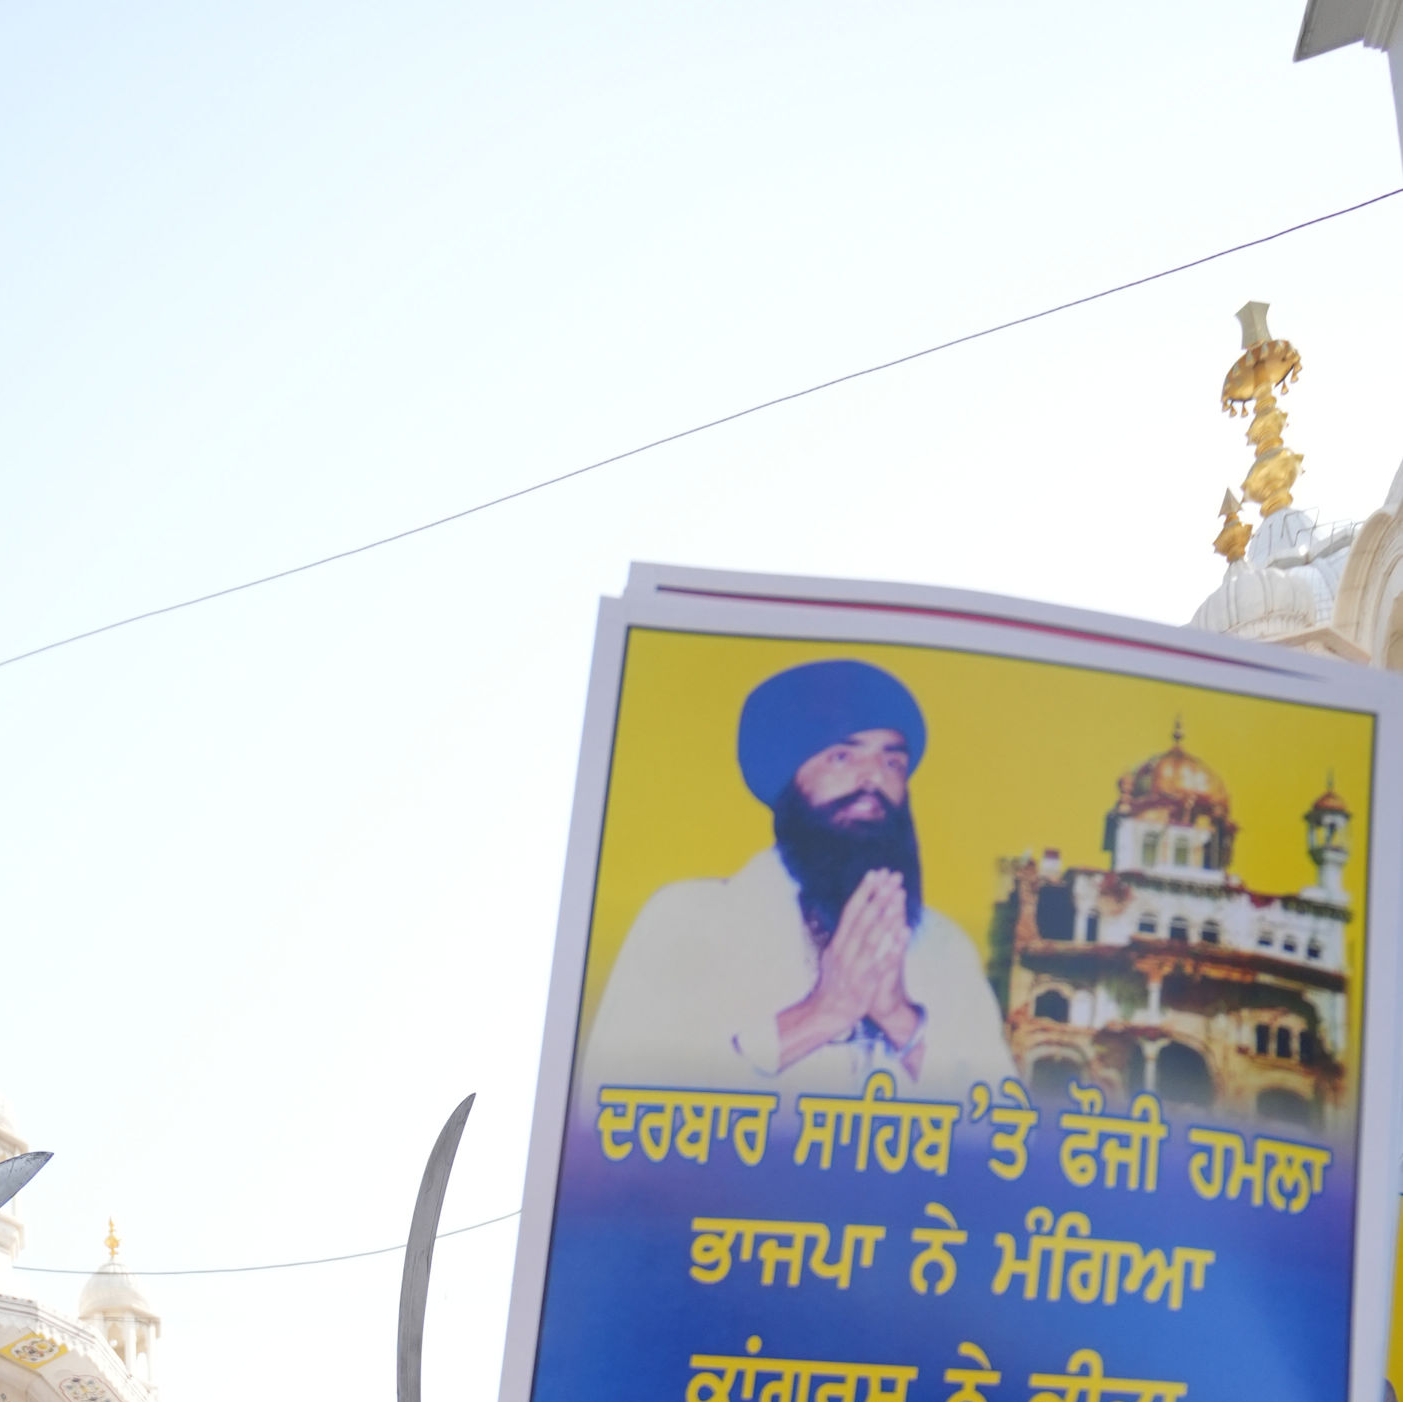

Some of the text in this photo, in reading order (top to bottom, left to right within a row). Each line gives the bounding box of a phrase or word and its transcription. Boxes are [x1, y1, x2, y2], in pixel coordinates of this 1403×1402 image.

[598, 1086, 777, 1165] ਦਰਬਾਰ
[796, 1072, 960, 1176] ਸਾਹਿਬ
[1060, 1082, 1168, 1192] ਫੌਜੀ
[1189, 1129, 1331, 1212] ਹਮਲਾ
[689, 1202, 1216, 1311] ਭਾਜਪਾ ਨੇ ਮੰਗਿਆ
